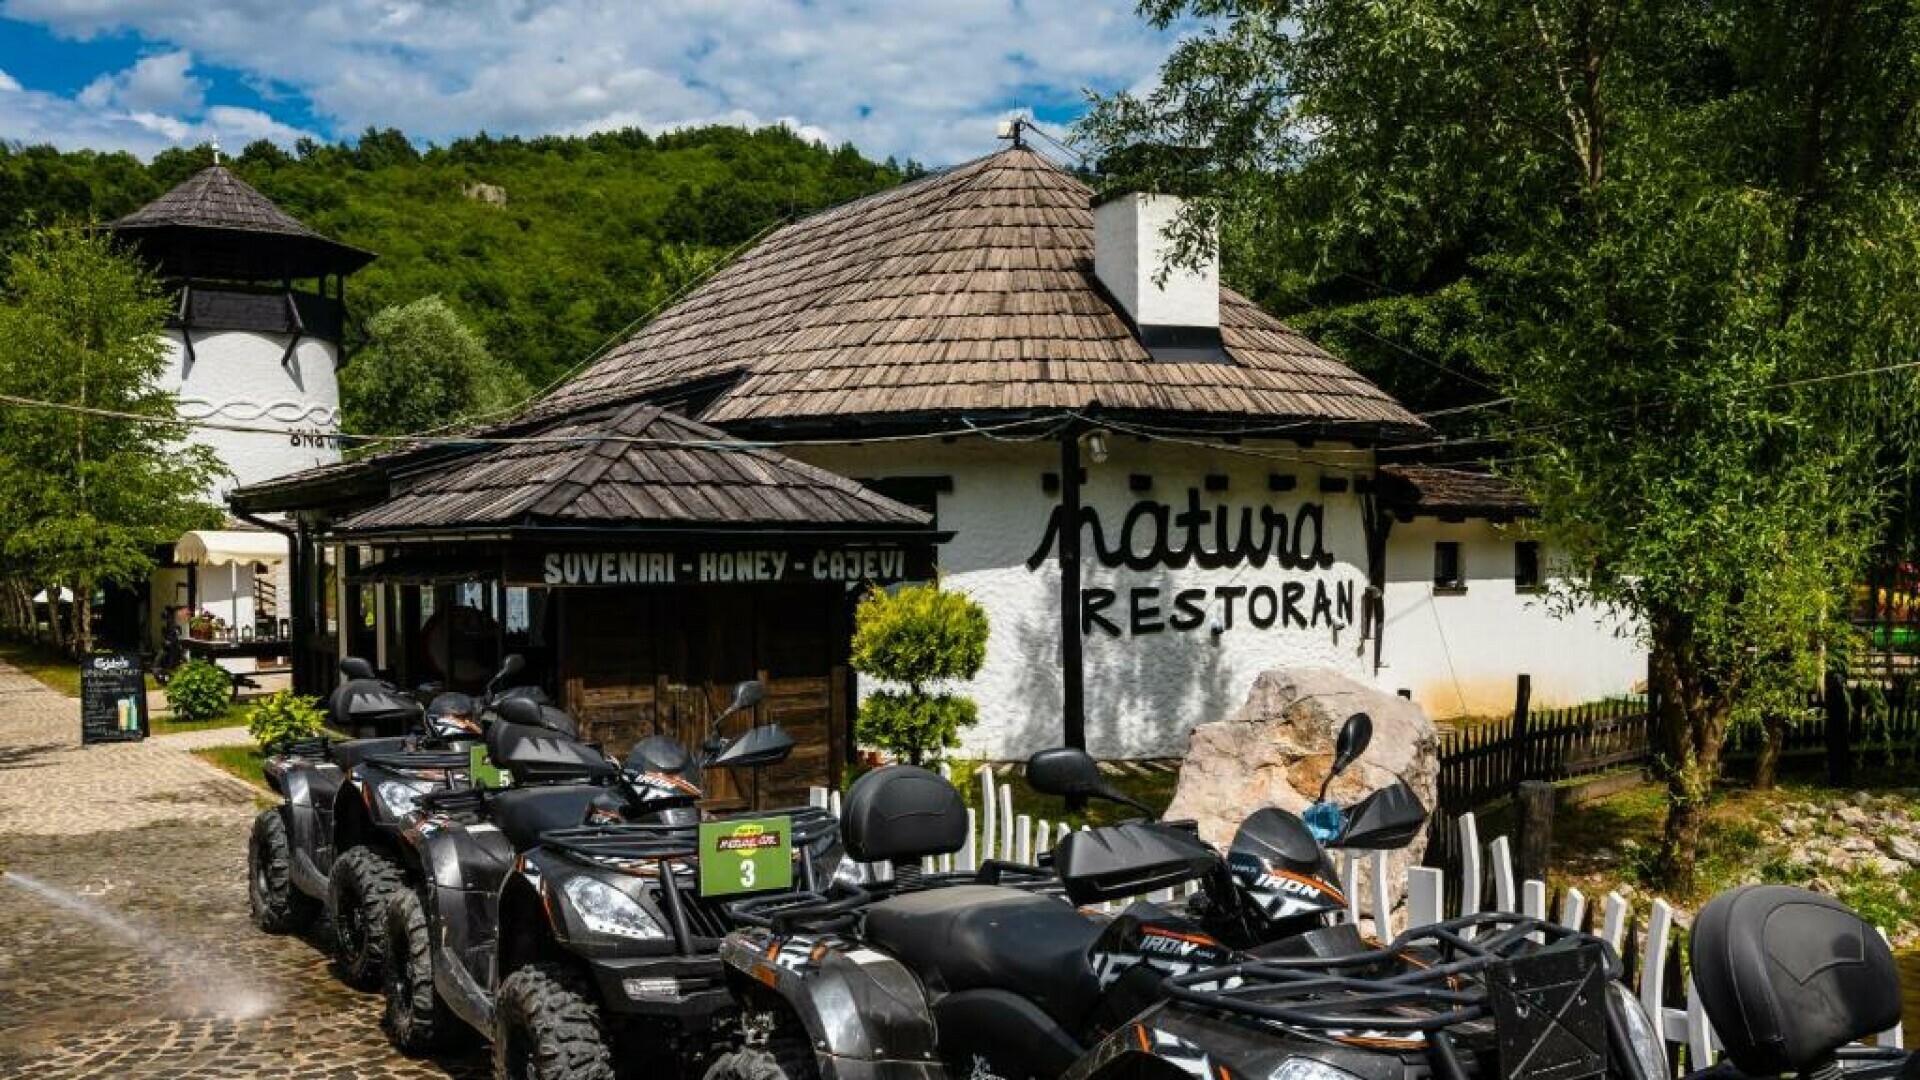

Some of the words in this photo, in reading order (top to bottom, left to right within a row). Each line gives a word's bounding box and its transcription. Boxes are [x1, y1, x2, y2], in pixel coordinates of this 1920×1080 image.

[1026, 488, 1334, 572] natura
[544, 552, 676, 585] SUVENIRI
[700, 551, 787, 582] HONEY
[1081, 579, 1354, 638] RESTORAN
[499, 770, 510, 787] 5
[741, 859, 755, 888] 3
[1254, 873, 1321, 899] IRON
[1140, 934, 1199, 957] IRON
